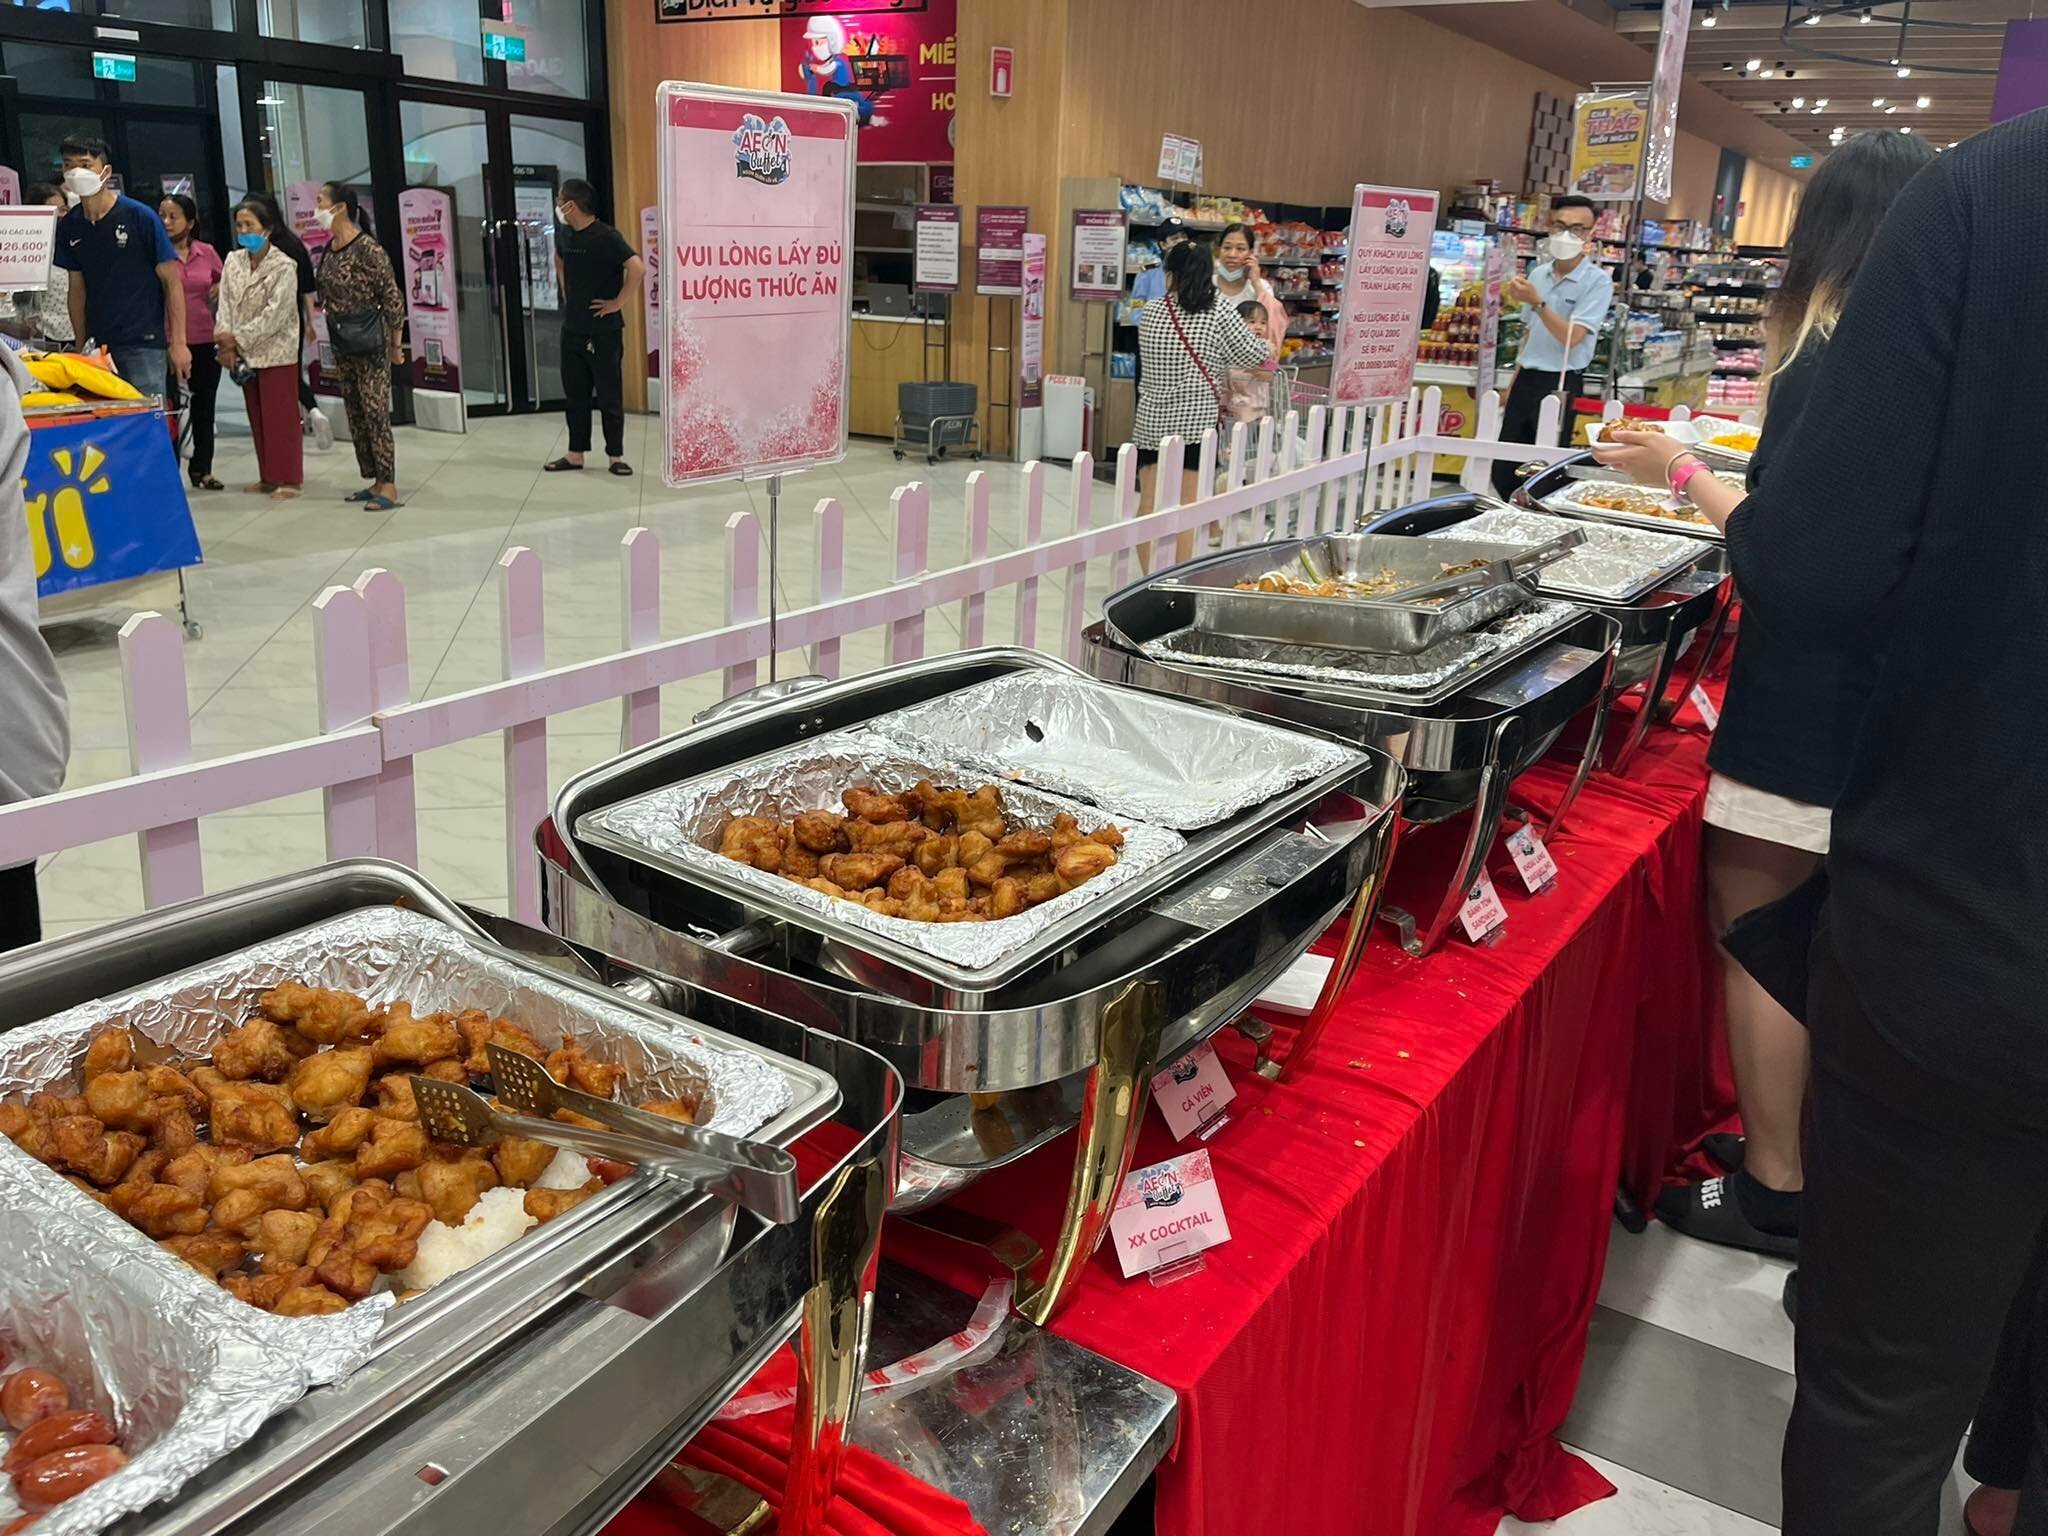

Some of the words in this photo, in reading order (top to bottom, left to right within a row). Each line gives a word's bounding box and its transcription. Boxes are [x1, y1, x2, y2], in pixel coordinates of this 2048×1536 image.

[740, 130, 786, 153] AEON
[750, 150, 780, 174] Buffet
[676, 245, 712, 267] VUI
[719, 239, 772, 266] LÒNG
[778, 237, 811, 265] LẤY
[815, 239, 841, 265] ĐỦ
[682, 275, 752, 304] LƯỢNG
[757, 271, 808, 297] THỨC
[811, 271, 837, 295] ĂN
[1181, 1095, 1195, 1112] CÁ
[1193, 1083, 1214, 1103] VIÊN
[1143, 1170, 1178, 1193] AEON
[1128, 1232, 1148, 1249] XX
[1149, 1211, 1213, 1242] COCKTAIL
